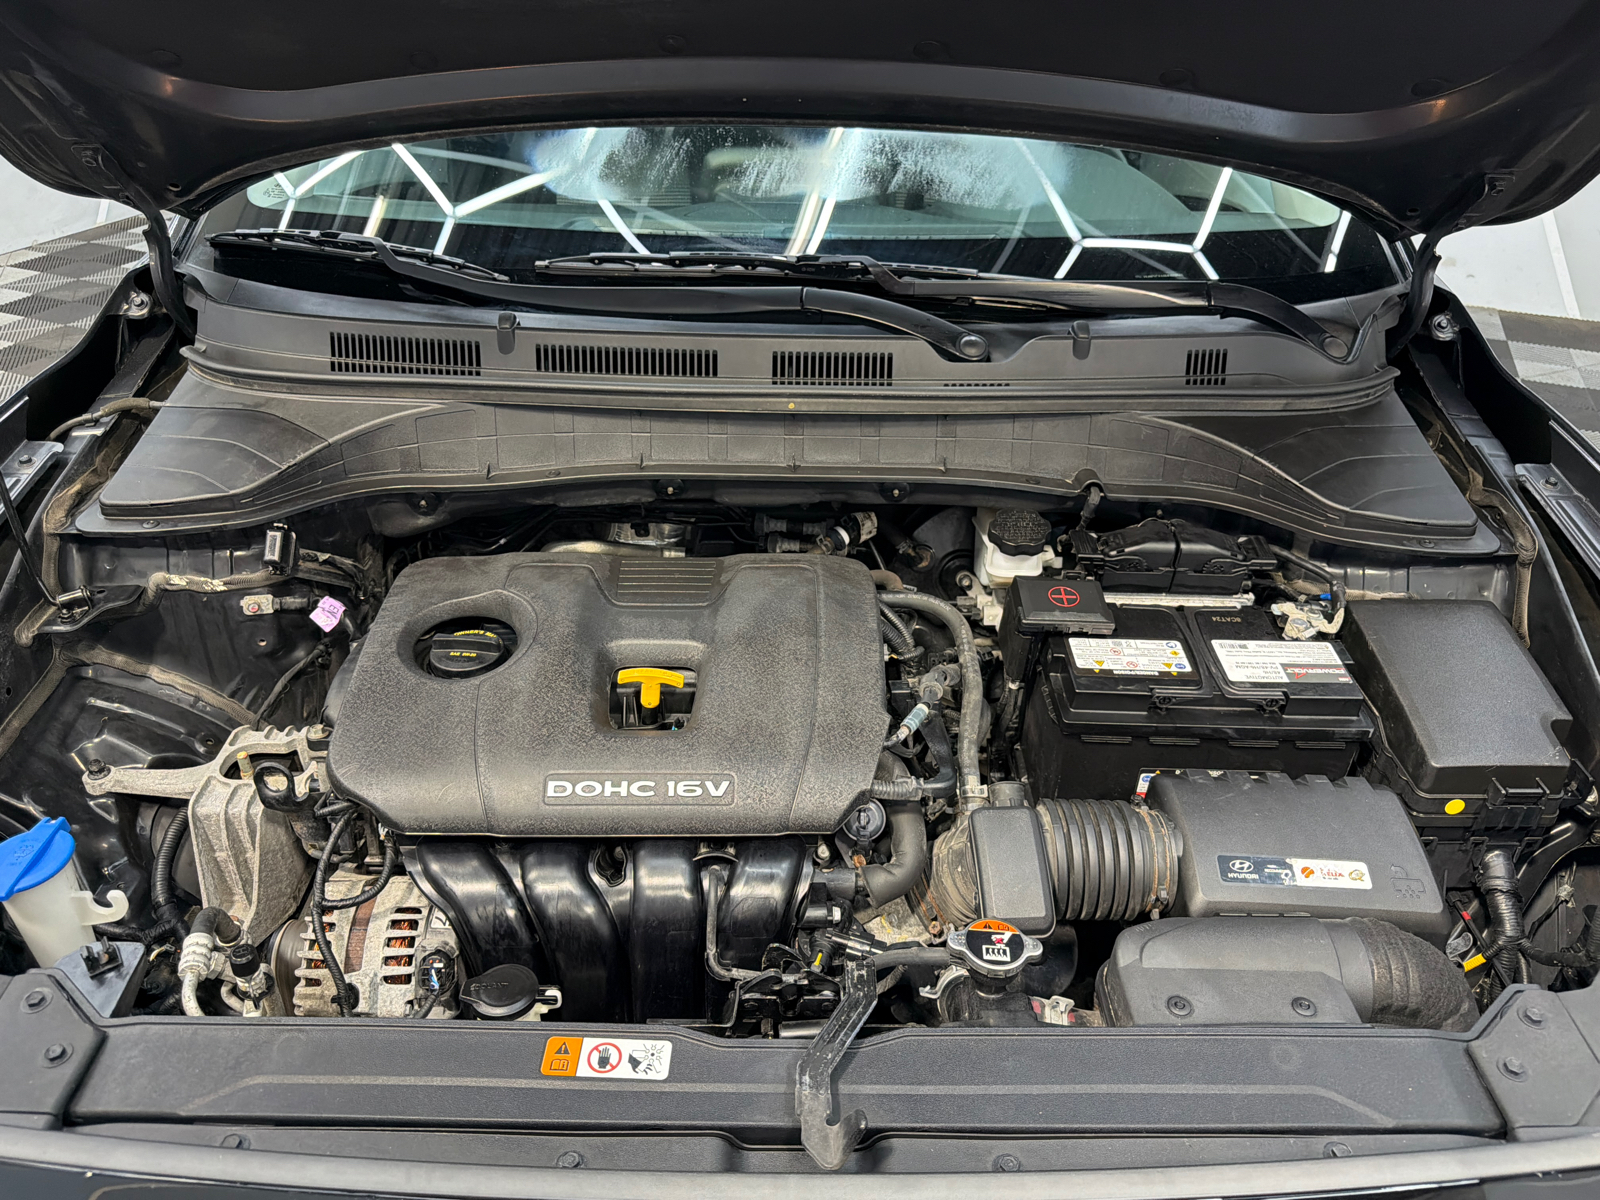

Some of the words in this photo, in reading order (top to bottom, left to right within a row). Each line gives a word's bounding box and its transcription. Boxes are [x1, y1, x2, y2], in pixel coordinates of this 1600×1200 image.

[547, 780, 656, 797] DOHC
[667, 780, 731, 797] 16V
[1228, 872, 1259, 880] HYUNDAI
